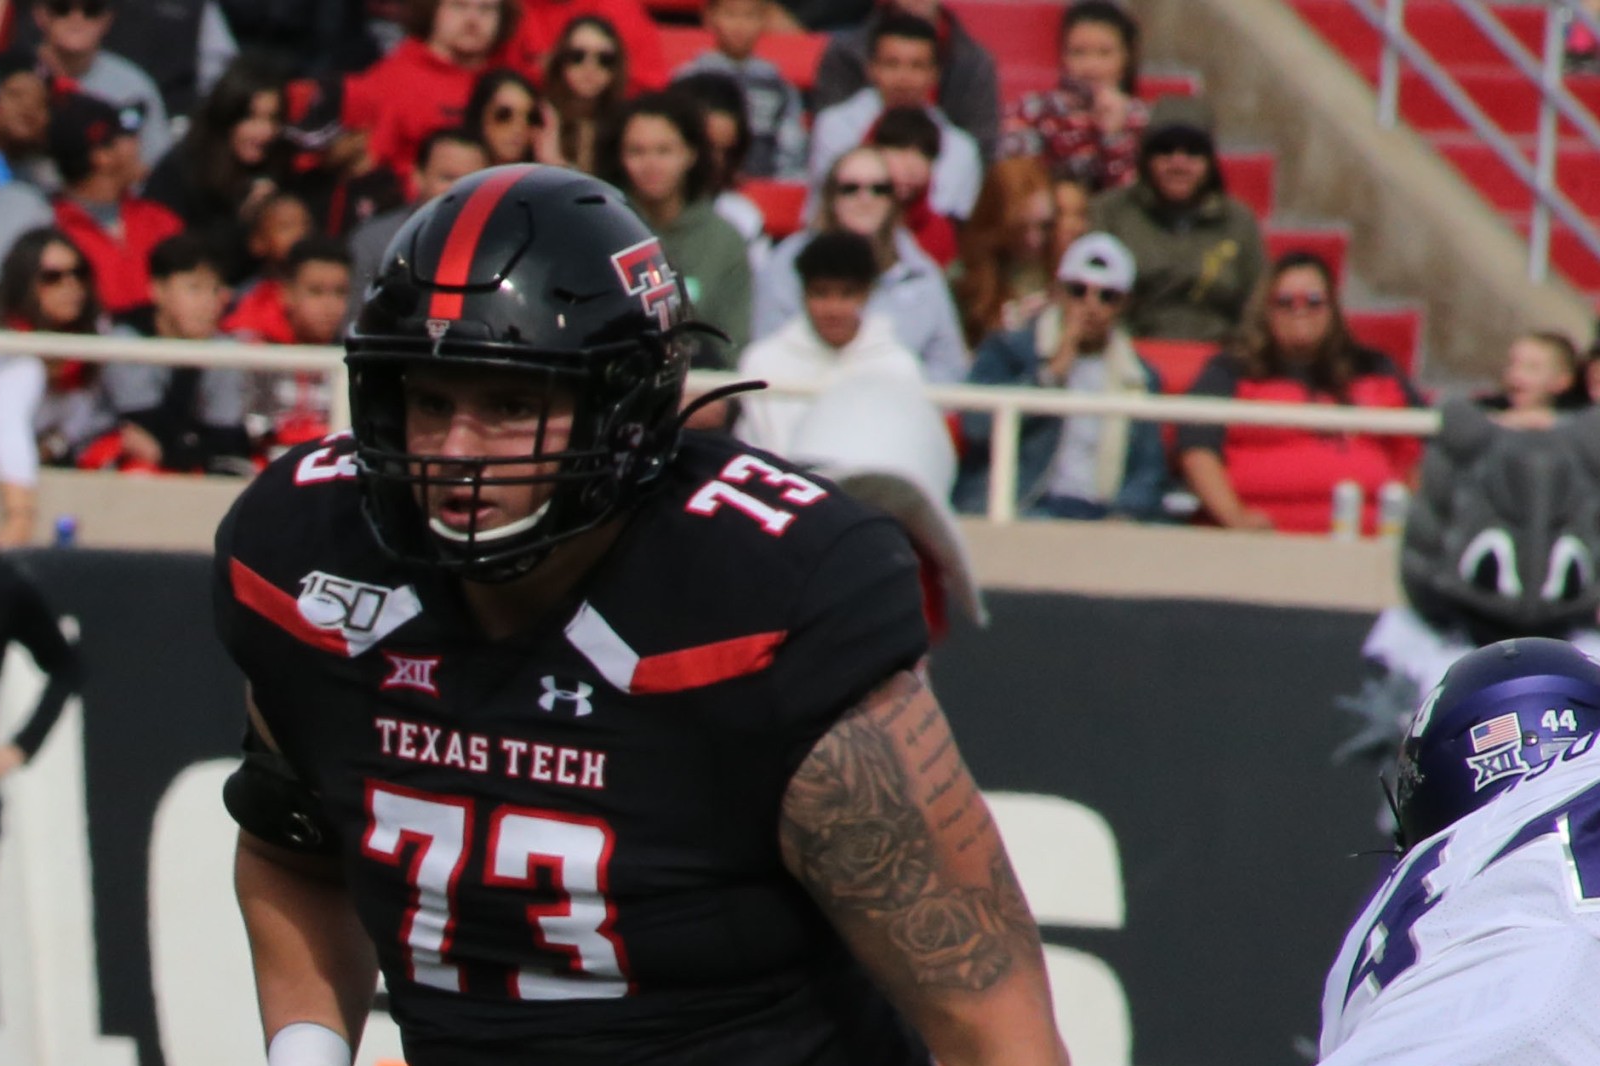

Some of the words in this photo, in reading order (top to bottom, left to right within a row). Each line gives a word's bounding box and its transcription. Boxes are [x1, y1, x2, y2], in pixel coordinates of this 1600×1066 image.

[294, 430, 359, 486] 3
[684, 452, 830, 538] 73
[300, 573, 390, 633] 150
[382, 653, 441, 695] XII
[1541, 709, 1578, 732] 44
[376, 717, 489, 773] TEXAS
[501, 737, 606, 788] TECH
[1468, 743, 1529, 791] XII
[362, 777, 639, 1001] 73
